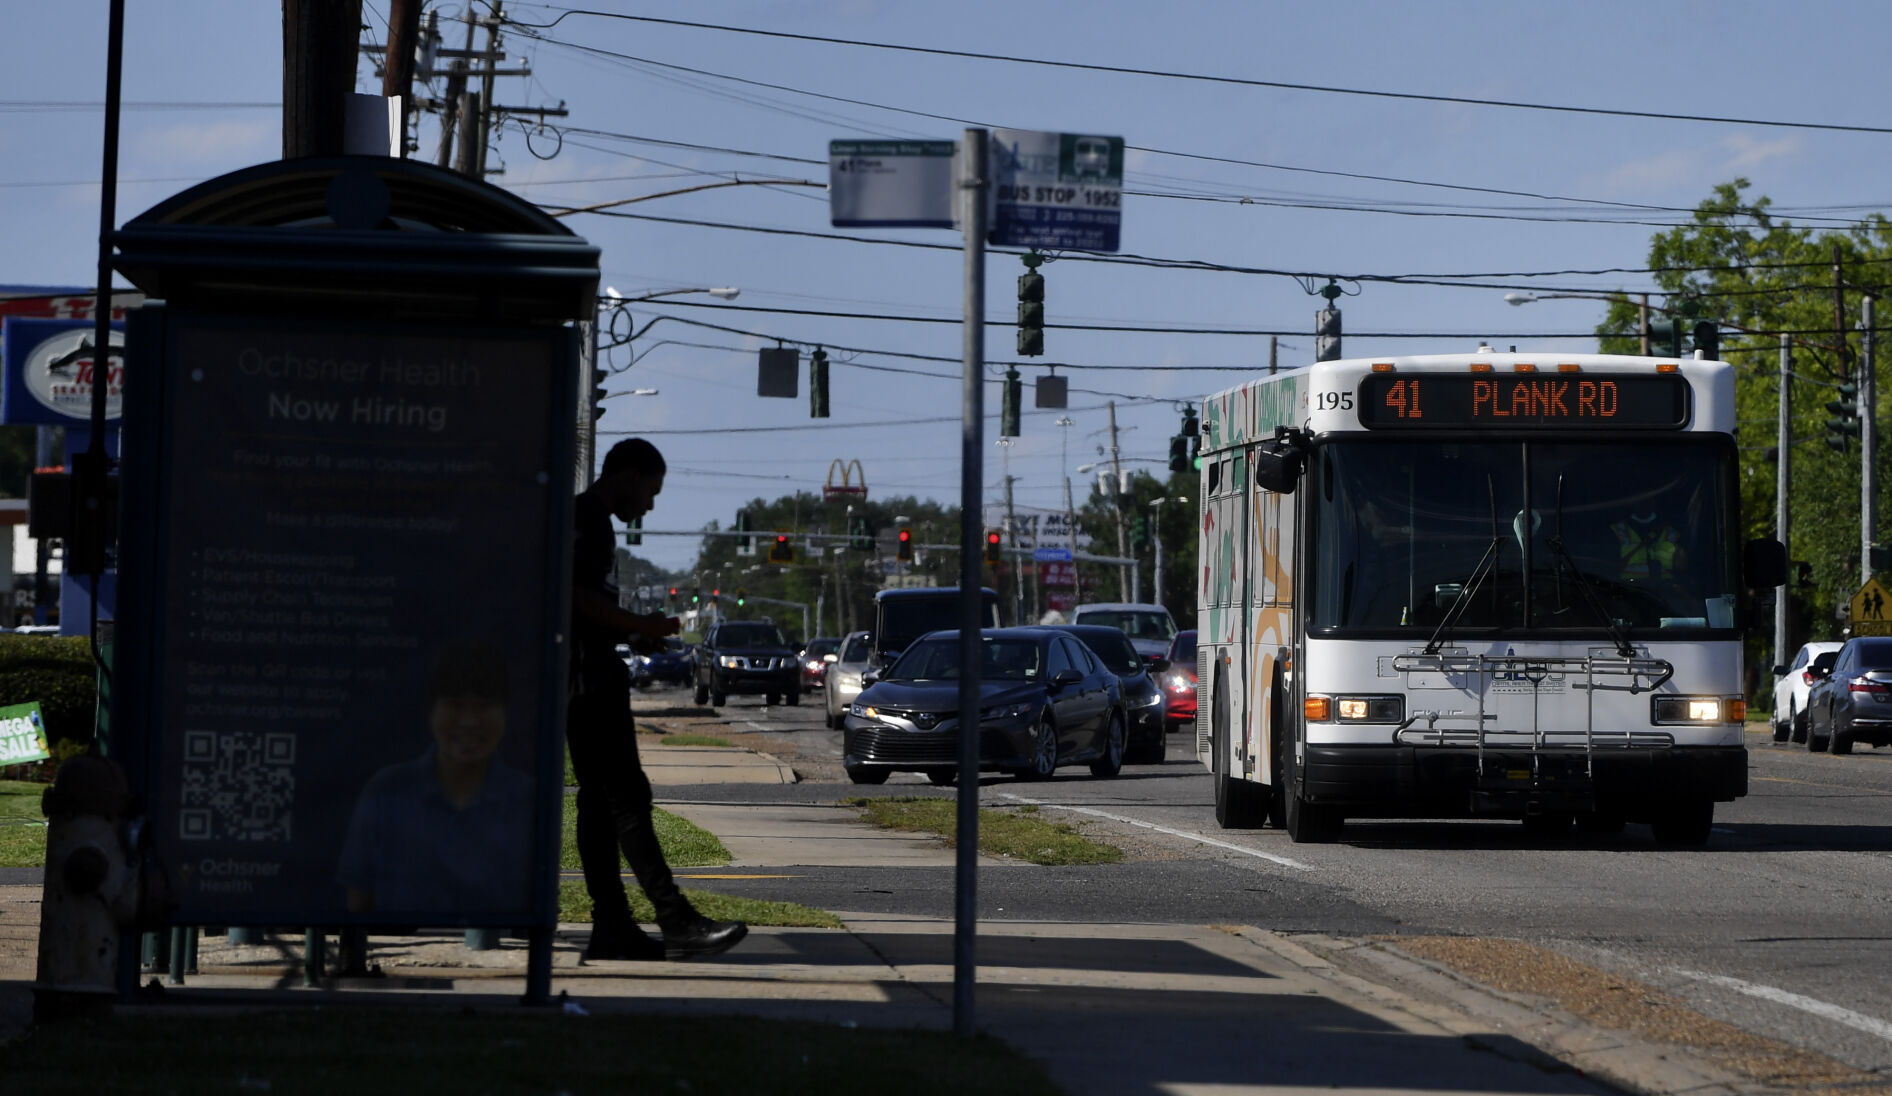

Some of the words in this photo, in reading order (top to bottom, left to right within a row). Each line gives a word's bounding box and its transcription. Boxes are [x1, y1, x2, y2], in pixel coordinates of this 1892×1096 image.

[998, 186, 1030, 201] BUS
[1035, 186, 1076, 203] STOP
[237, 347, 371, 382] Ochsner
[379, 354, 480, 387] Health
[1316, 391, 1354, 411] 195
[1386, 380, 1422, 418] 41
[1473, 381, 1568, 417] PLANK
[1578, 381, 1618, 417] RD
[268, 392, 340, 421] Now
[351, 395, 448, 432] Hiring
[233, 449, 270, 466] Find
[274, 454, 310, 469] your
[314, 453, 332, 469] fit
[336, 455, 371, 470] with
[325, 512, 404, 530] difference
[202, 568, 259, 584] Patient
[201, 589, 257, 605] Supply
[201, 608, 296, 624] Van/Shuttle
[300, 610, 329, 625] Bus
[333, 612, 389, 627] Drivers
[201, 628, 243, 643] Food
[246, 629, 278, 644] and
[281, 631, 351, 646] Nutrition
[217, 682, 280, 698] website
[0, 733, 41, 761] SALE
[199, 857, 282, 877] Ochsner
[199, 879, 254, 893] Health
